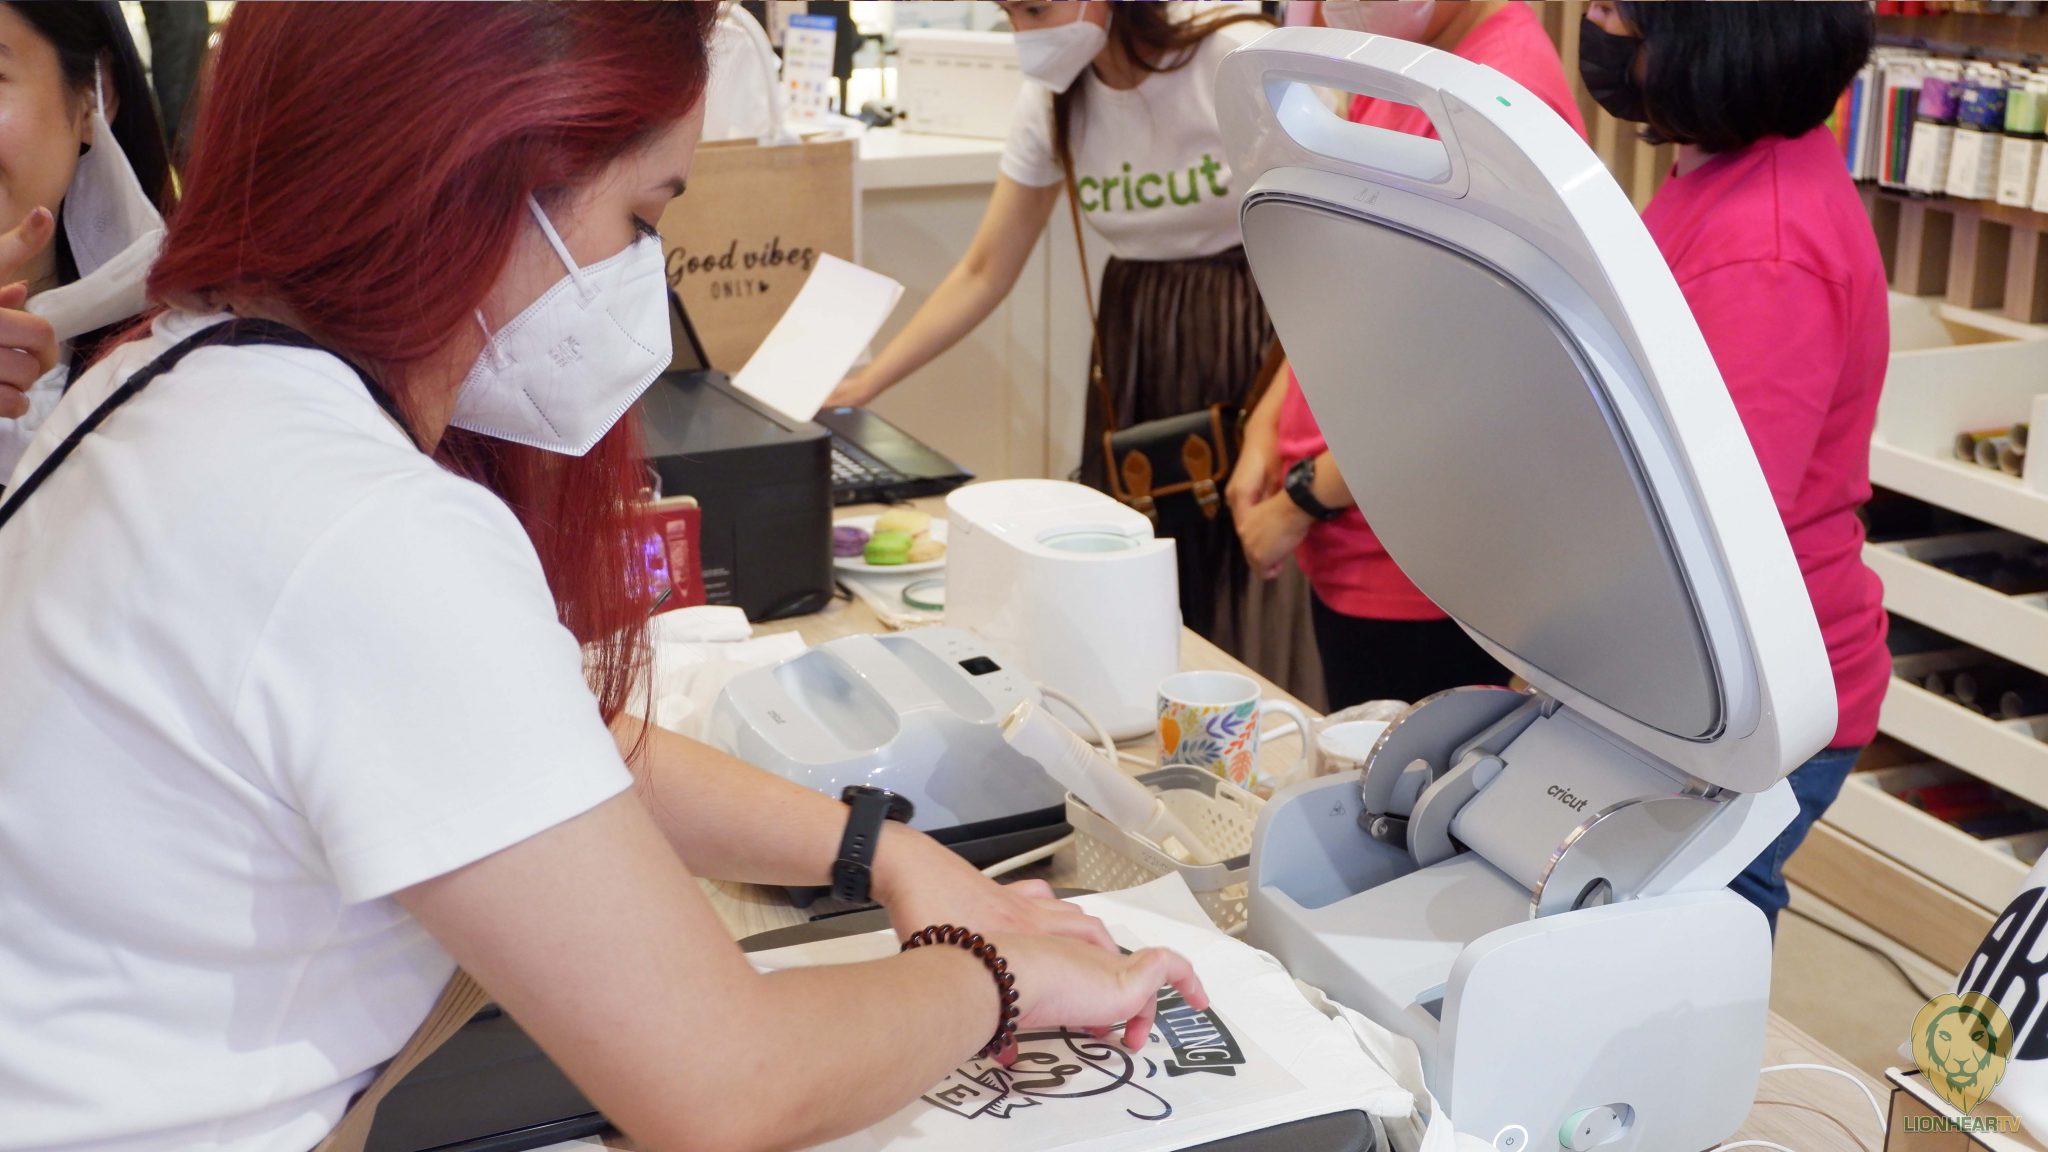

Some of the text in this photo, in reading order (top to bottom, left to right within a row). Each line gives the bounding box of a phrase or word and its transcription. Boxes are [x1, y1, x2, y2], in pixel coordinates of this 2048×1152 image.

[1079, 153, 1229, 212] cricut
[665, 236, 814, 287] Good vibes
[710, 280, 755, 299] ONLY
[1547, 785, 1588, 812] cricut
